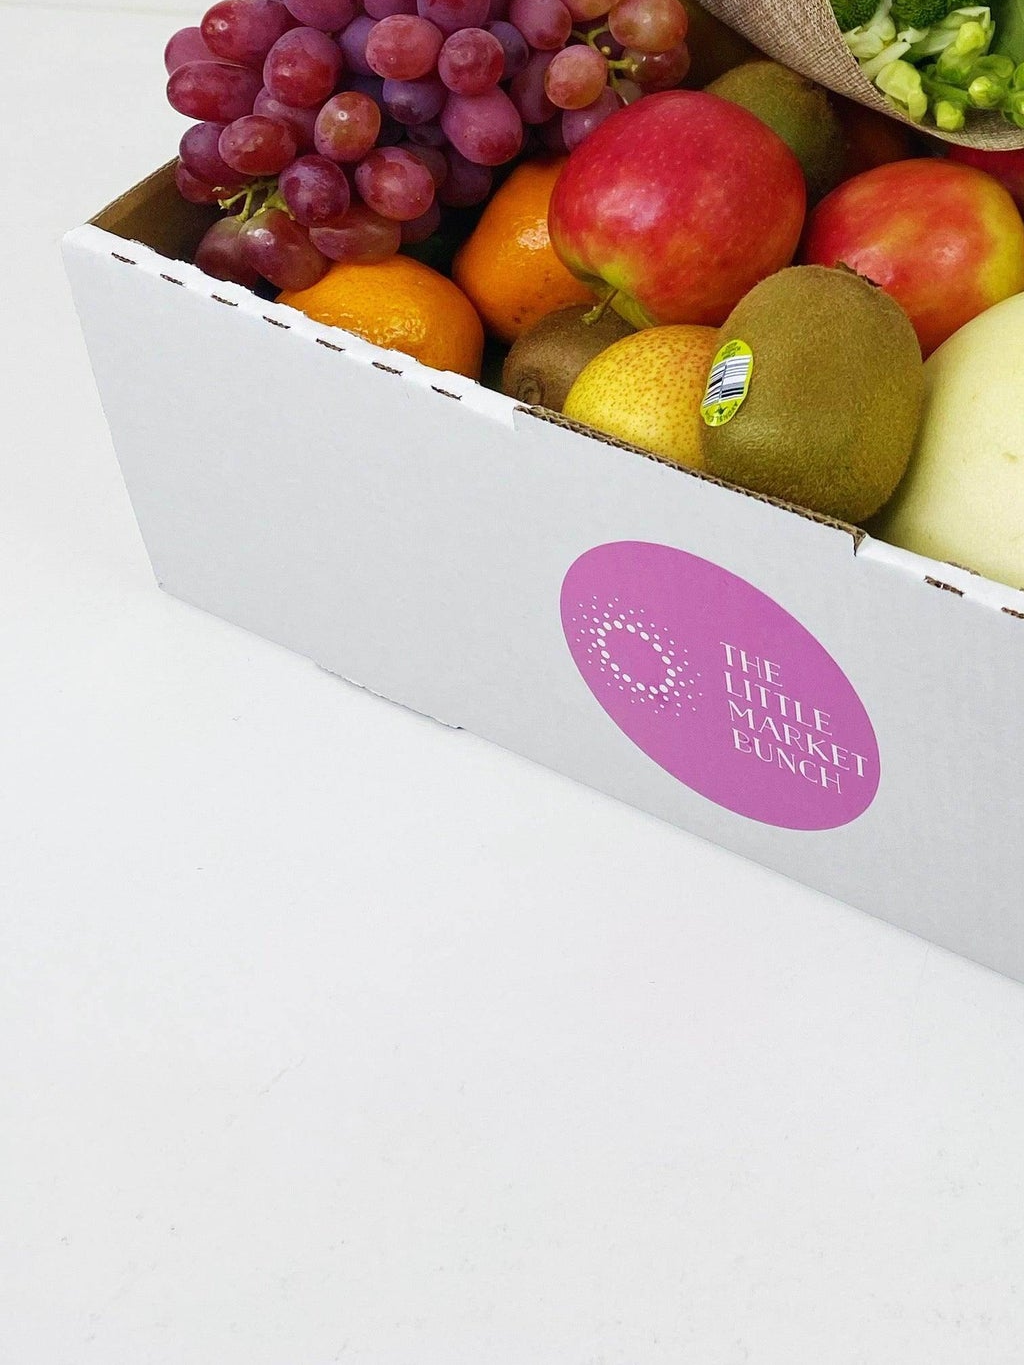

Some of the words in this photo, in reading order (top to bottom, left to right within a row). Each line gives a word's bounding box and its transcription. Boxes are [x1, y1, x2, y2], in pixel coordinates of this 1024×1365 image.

[720, 641, 783, 687] THE
[724, 670, 833, 737] LITTLE
[728, 699, 868, 778] MARKET
[732, 727, 842, 795] BUNCH
